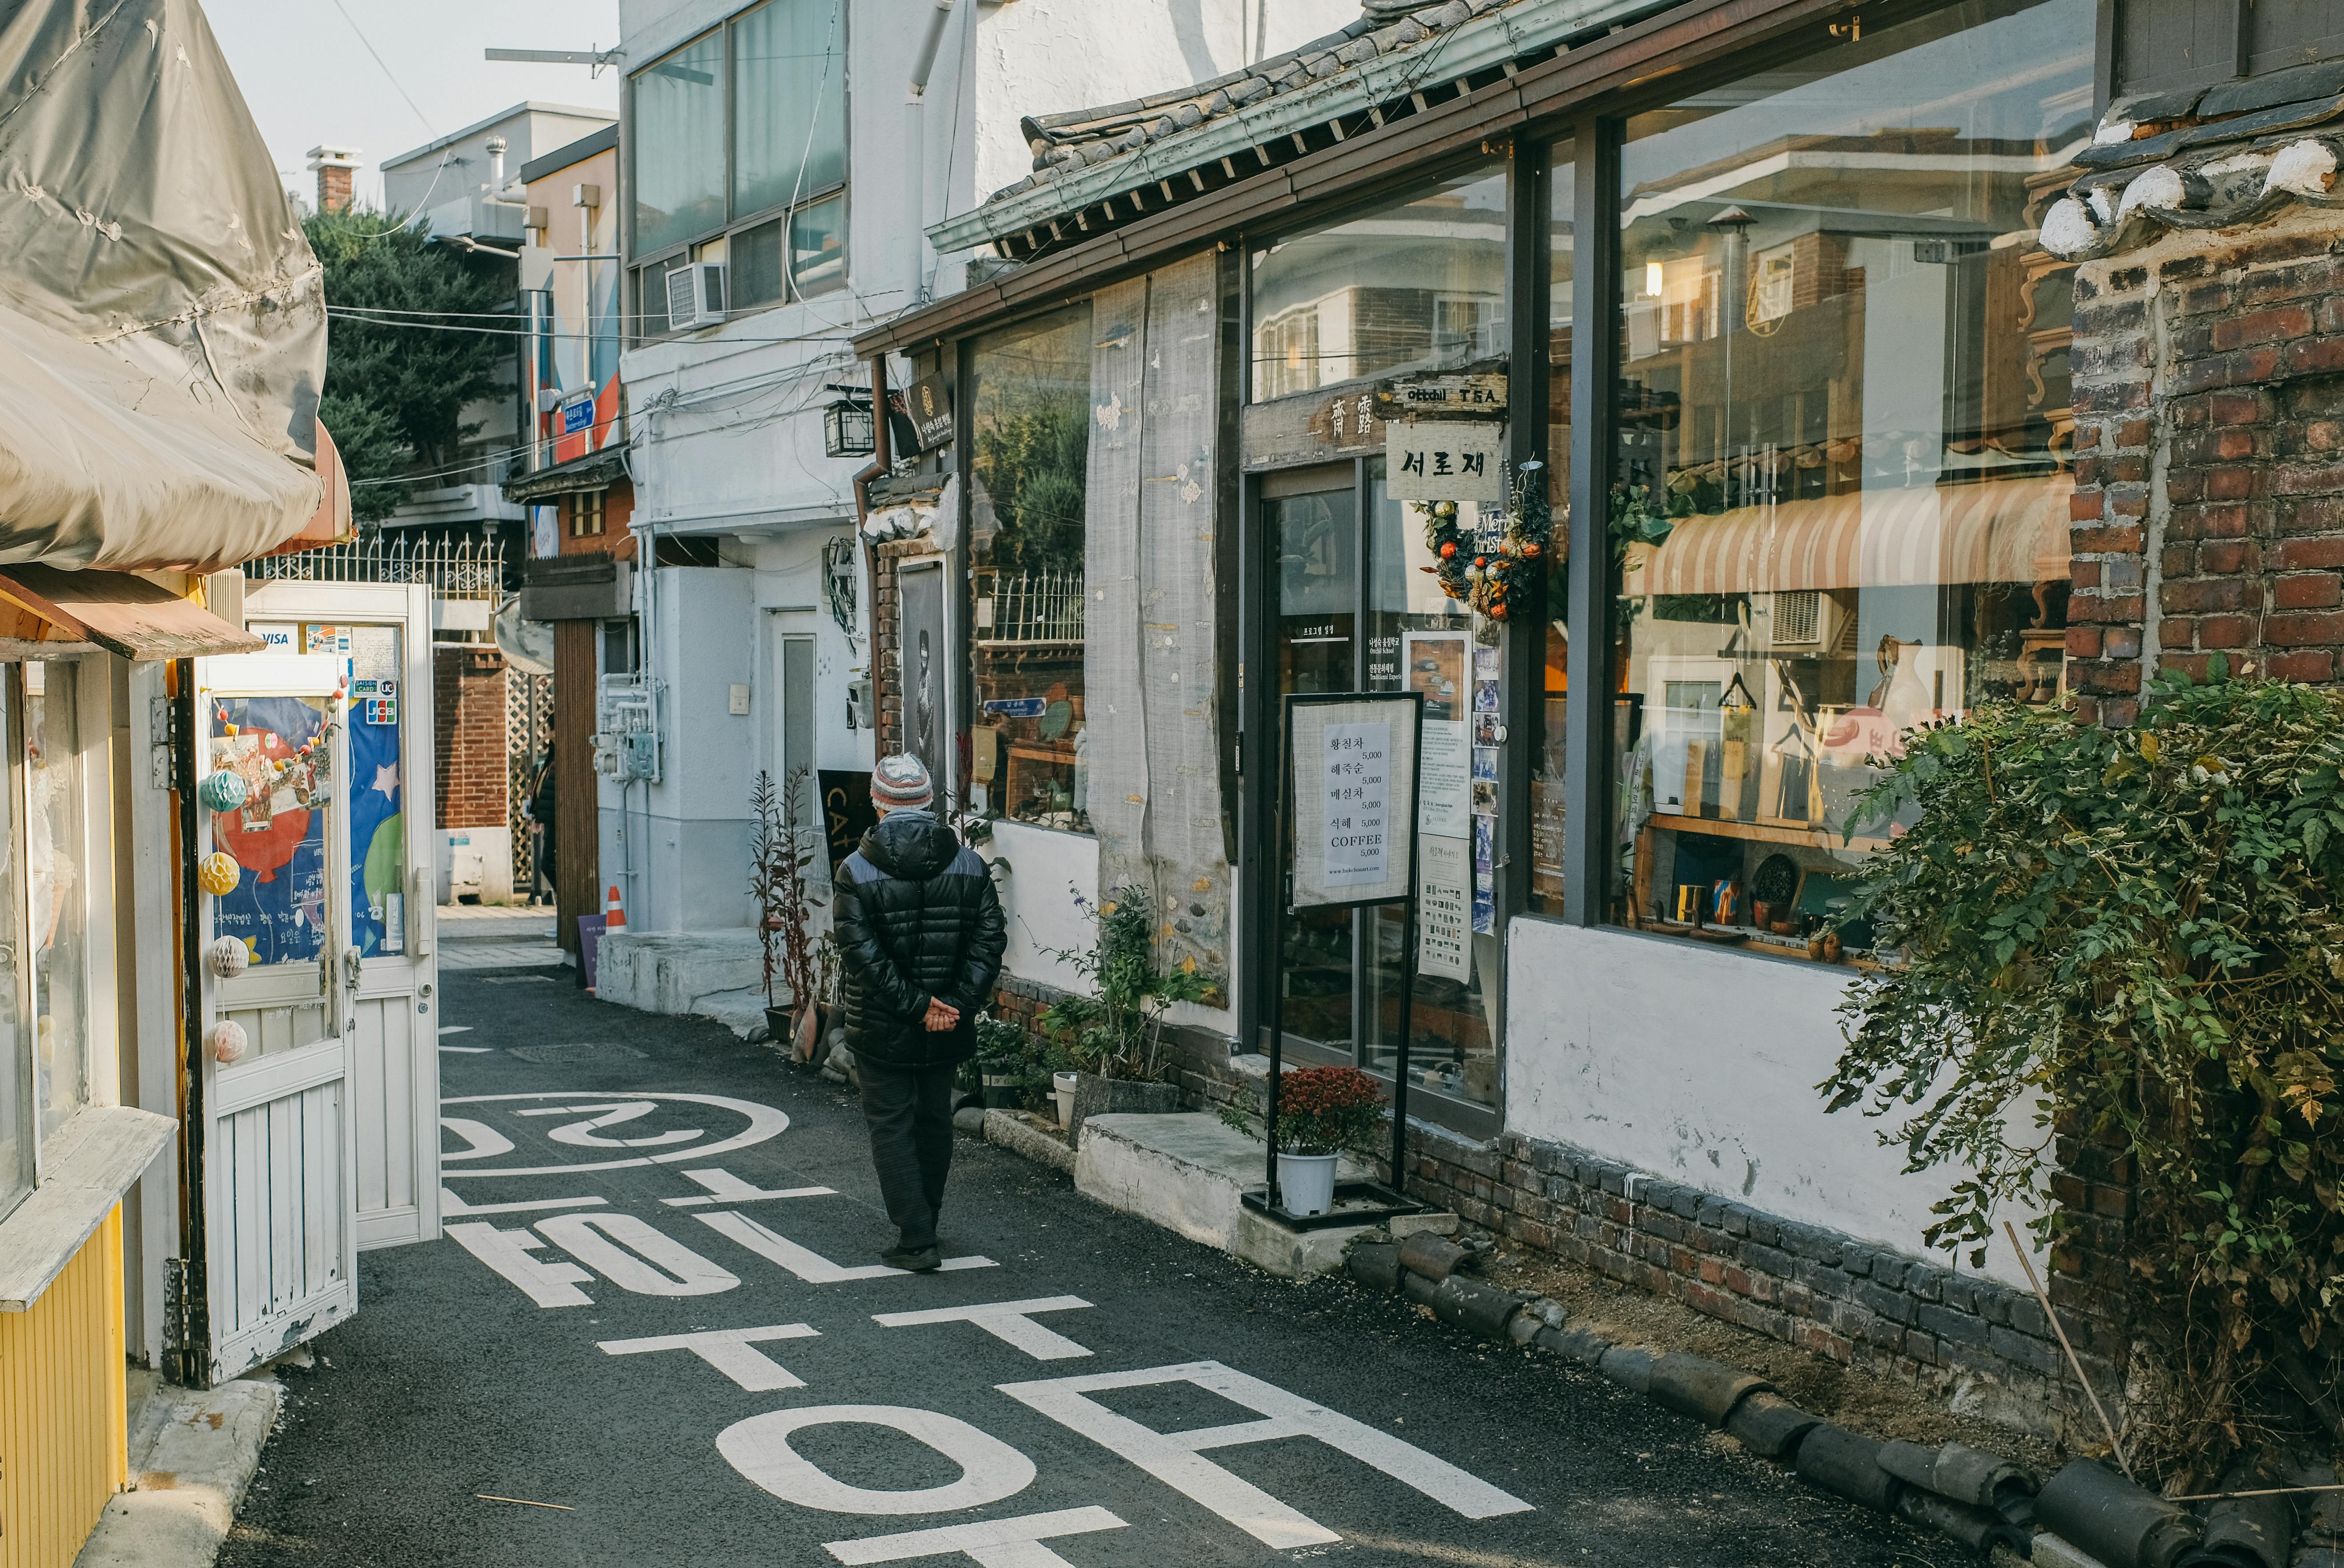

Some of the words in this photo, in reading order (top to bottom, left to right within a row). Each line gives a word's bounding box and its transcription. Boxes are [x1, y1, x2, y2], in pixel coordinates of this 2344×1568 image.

[1459, 389, 1496, 403] TEA
[1401, 451, 1484, 477] 서로재
[261, 633, 288, 644] VISA
[381, 684, 393, 693] UC
[368, 707, 395, 716] JCB
[1330, 737, 1364, 750] 황칠차
[1362, 751, 1382, 760] 5,000
[1362, 776, 1381, 785] 5,000
[1330, 787, 1364, 800] 매실차
[1362, 801, 1381, 810] 5,000
[1330, 817, 1351, 830] 식혜
[1361, 818, 1380, 828] 5,000
[1331, 834, 1382, 847] COFFEE
[1361, 848, 1379, 858] 5,000
[1329, 866, 1380, 874] www.bukchonart.com
